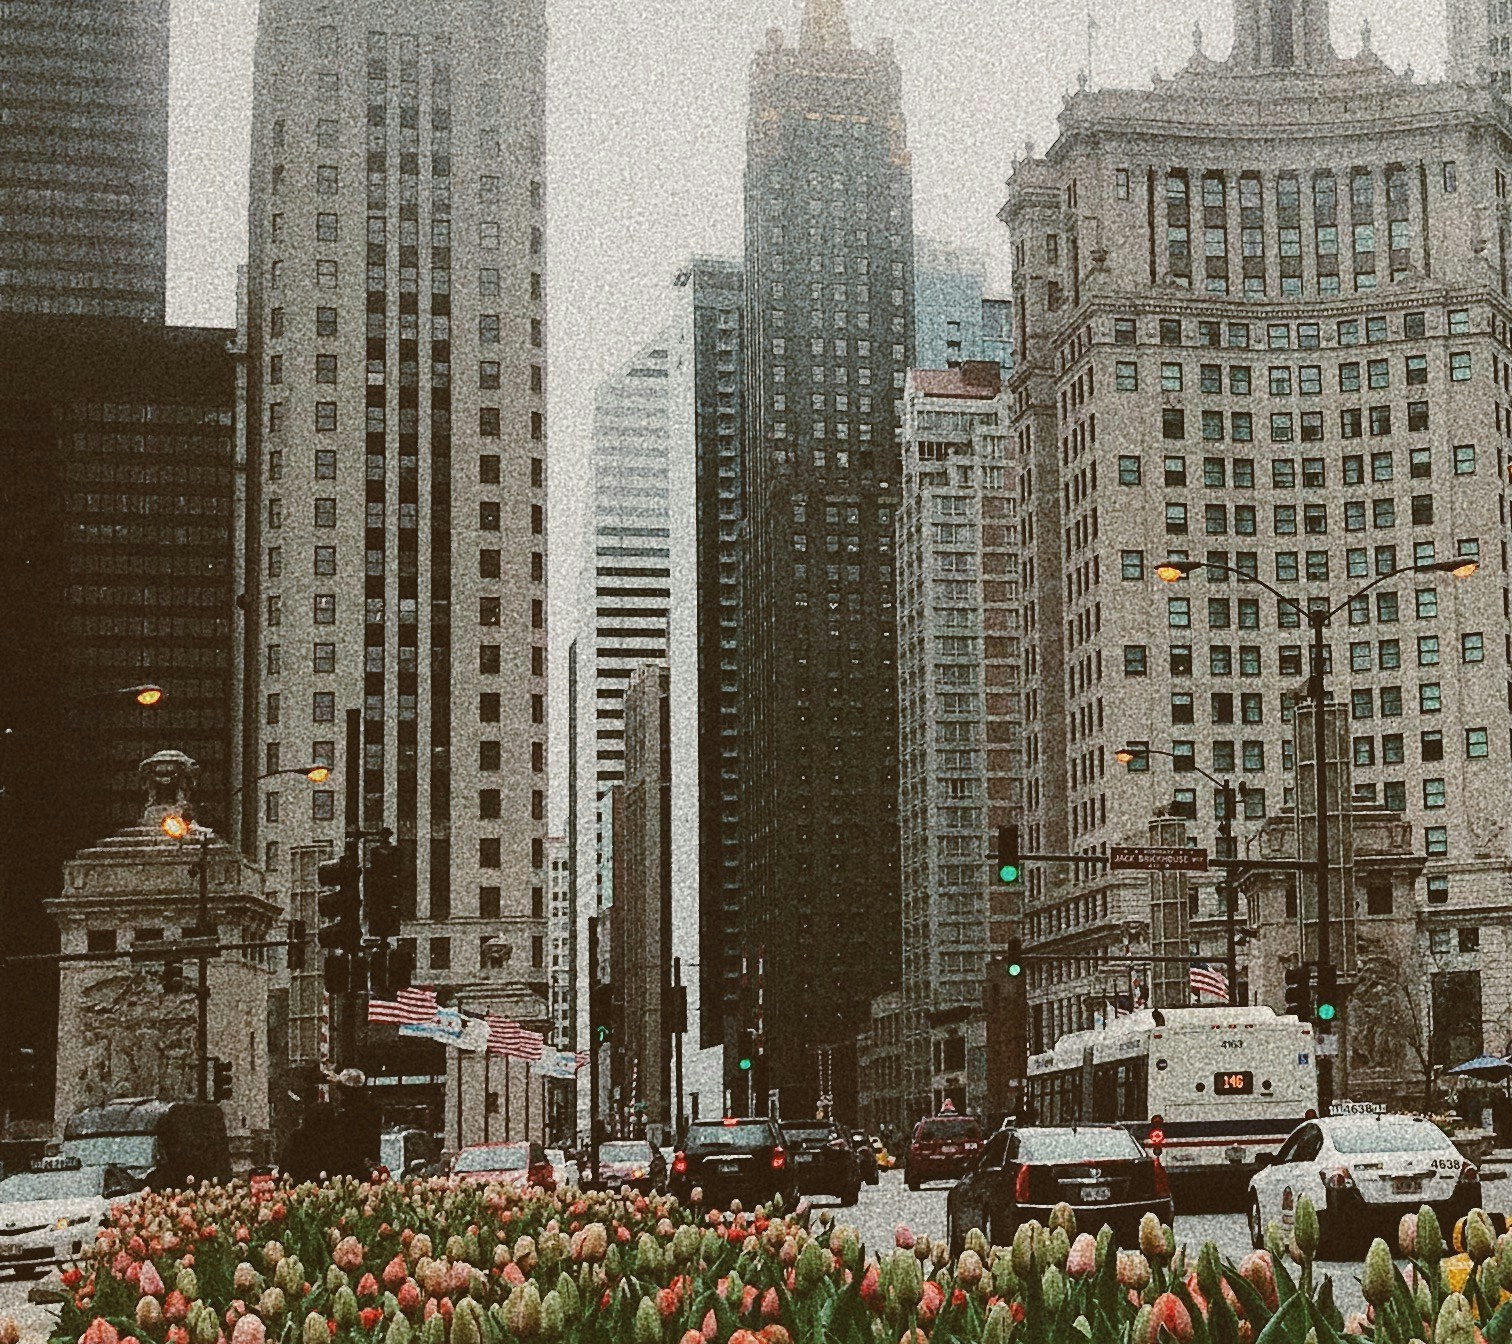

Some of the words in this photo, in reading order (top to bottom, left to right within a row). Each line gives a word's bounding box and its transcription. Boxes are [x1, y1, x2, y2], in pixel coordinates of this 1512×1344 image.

[1220, 1039, 1243, 1049] 4163
[1223, 1075, 1244, 1089] 146
[1343, 1104, 1371, 1114] 4638
[1431, 1159, 1461, 1170] 4638
